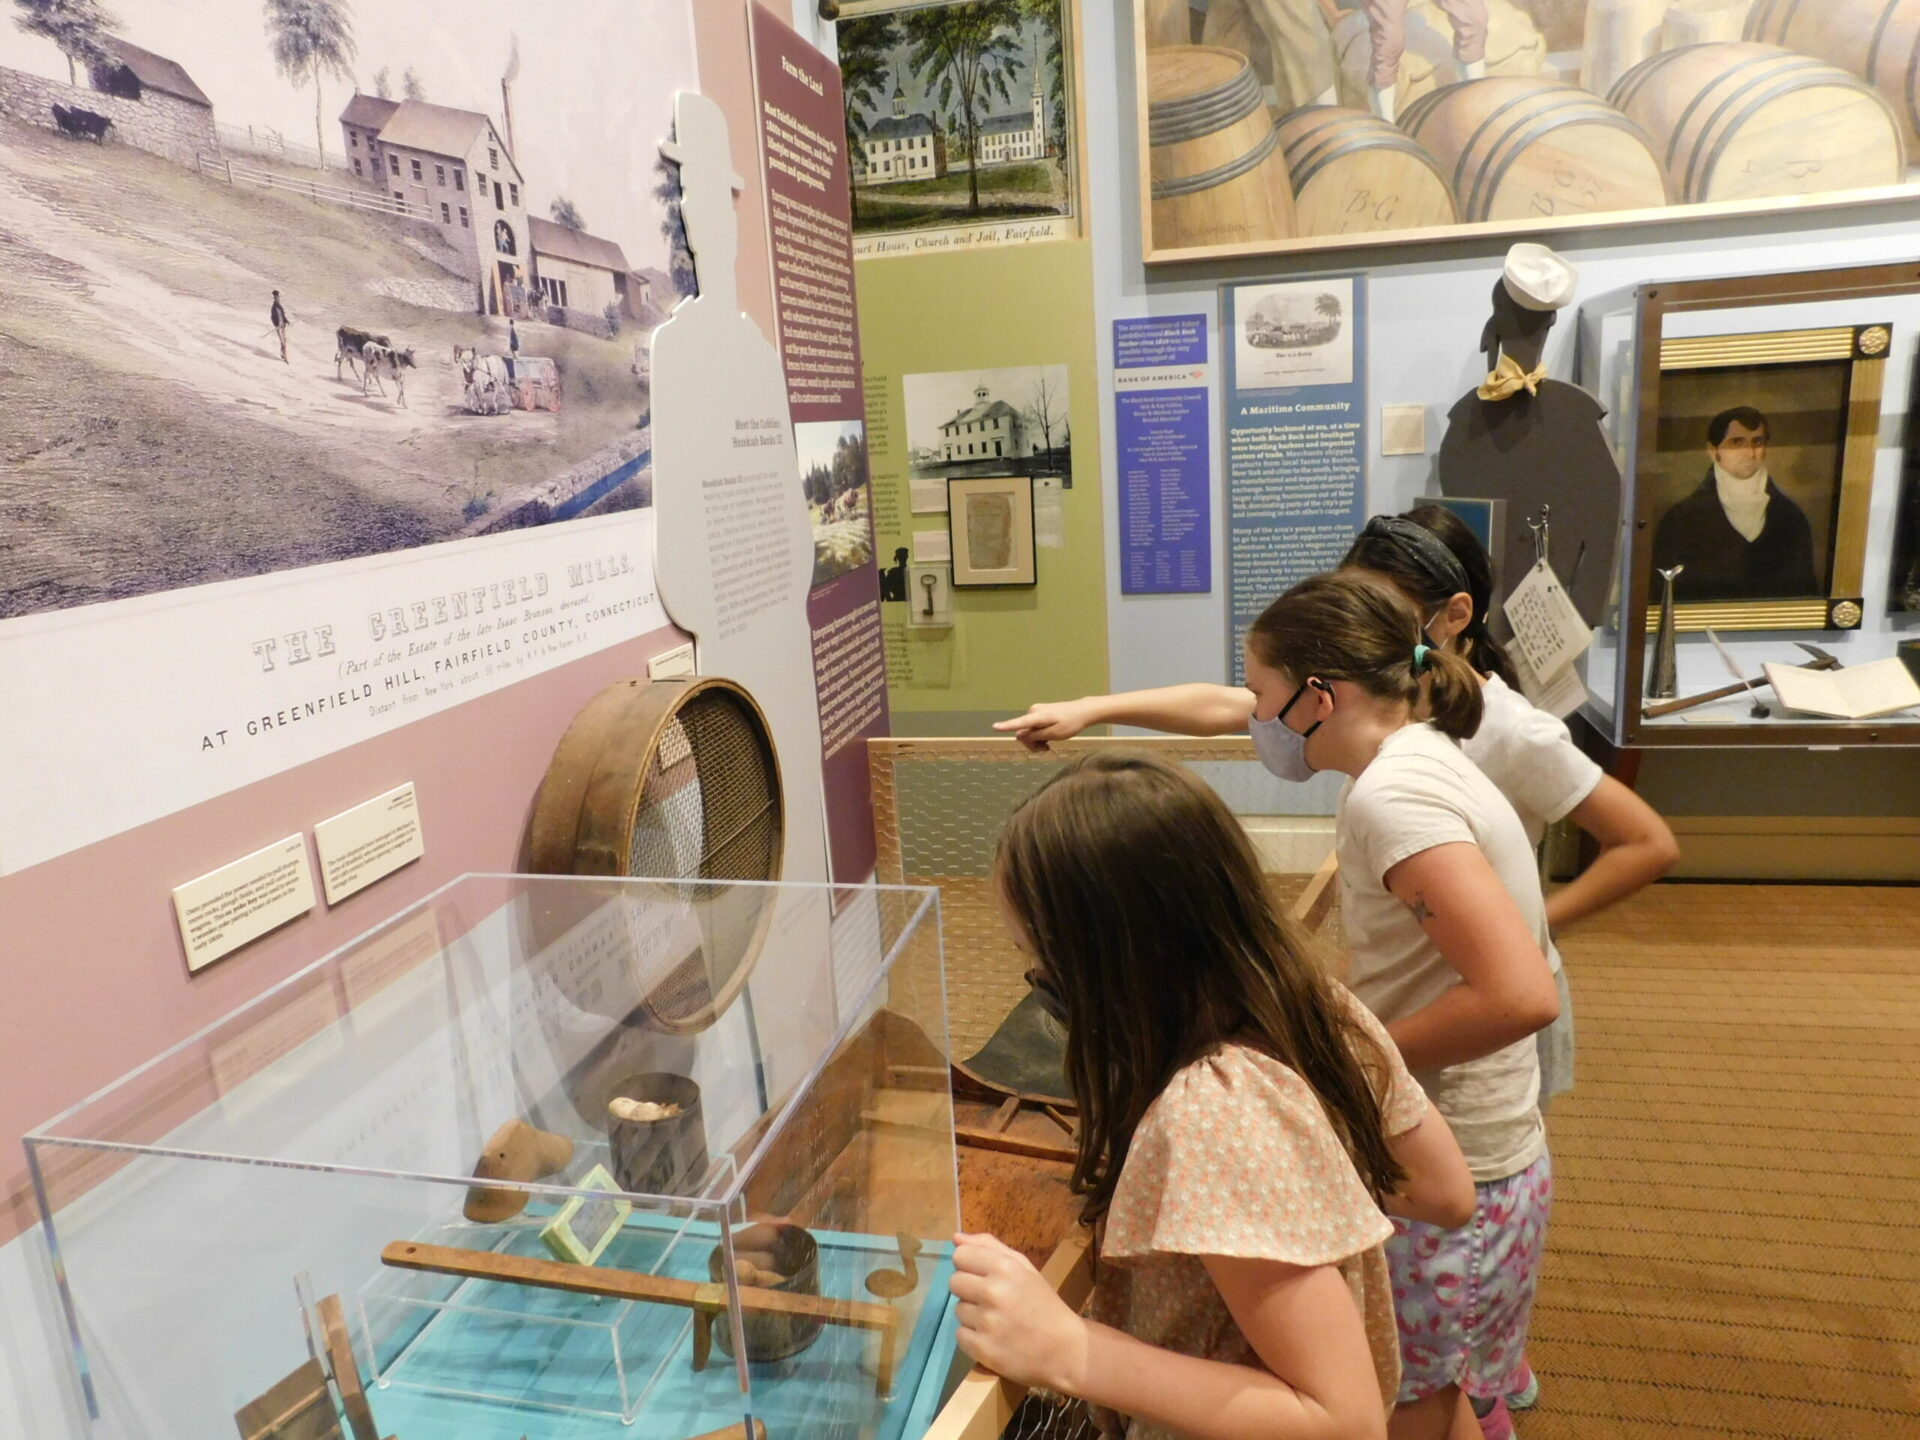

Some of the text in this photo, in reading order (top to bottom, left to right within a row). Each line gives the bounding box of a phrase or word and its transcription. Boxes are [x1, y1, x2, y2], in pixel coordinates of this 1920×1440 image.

[781, 55, 823, 96] Farm the Land
[764, 101, 776, 118] Most
[914, 233, 950, 249] Church
[953, 233, 972, 246] and
[976, 231, 1000, 243] Jail,
[1005, 225, 1054, 241] Fairfield.
[1240, 402, 1350, 414] A Maritime Community
[1230, 426, 1272, 435] Opportunity
[1320, 431, 1354, 439] Southport
[1249, 443, 1276, 451] bustling
[1320, 440, 1354, 448] important
[1324, 448, 1352, 457] shipped
[252, 624, 337, 673] THE
[368, 572, 549, 642] GREENFIELD
[373, 651, 385, 667] of
[388, 648, 402, 663] the
[408, 638, 437, 657] Estate
[444, 631, 453, 648] of
[457, 625, 471, 642] the
[477, 622, 492, 637] late
[496, 616, 518, 631] Isaac
[202, 729, 228, 751] AT
[246, 683, 373, 735] GREENFIELD
[434, 639, 511, 672] FAIRFIELD
[585, 592, 655, 622] CONNECTICUT
